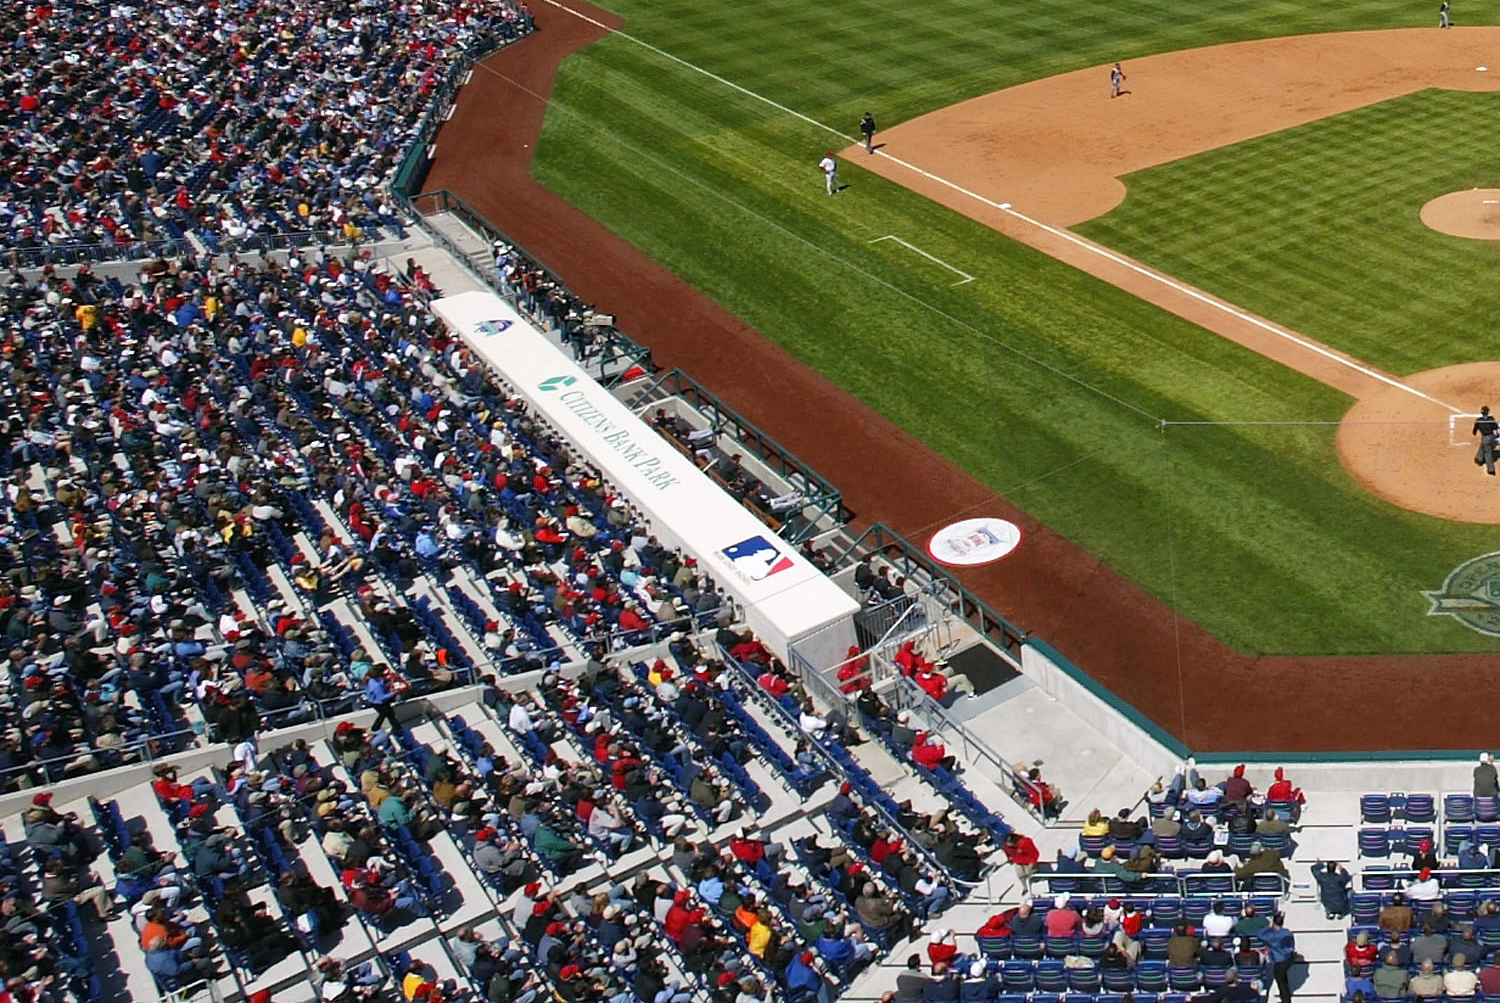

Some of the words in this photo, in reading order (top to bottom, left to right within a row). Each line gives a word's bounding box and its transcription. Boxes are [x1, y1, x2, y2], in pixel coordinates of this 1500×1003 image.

[560, 391, 617, 434] CITIZENS
[602, 429, 649, 463] BANK
[634, 457, 681, 491] PARK
